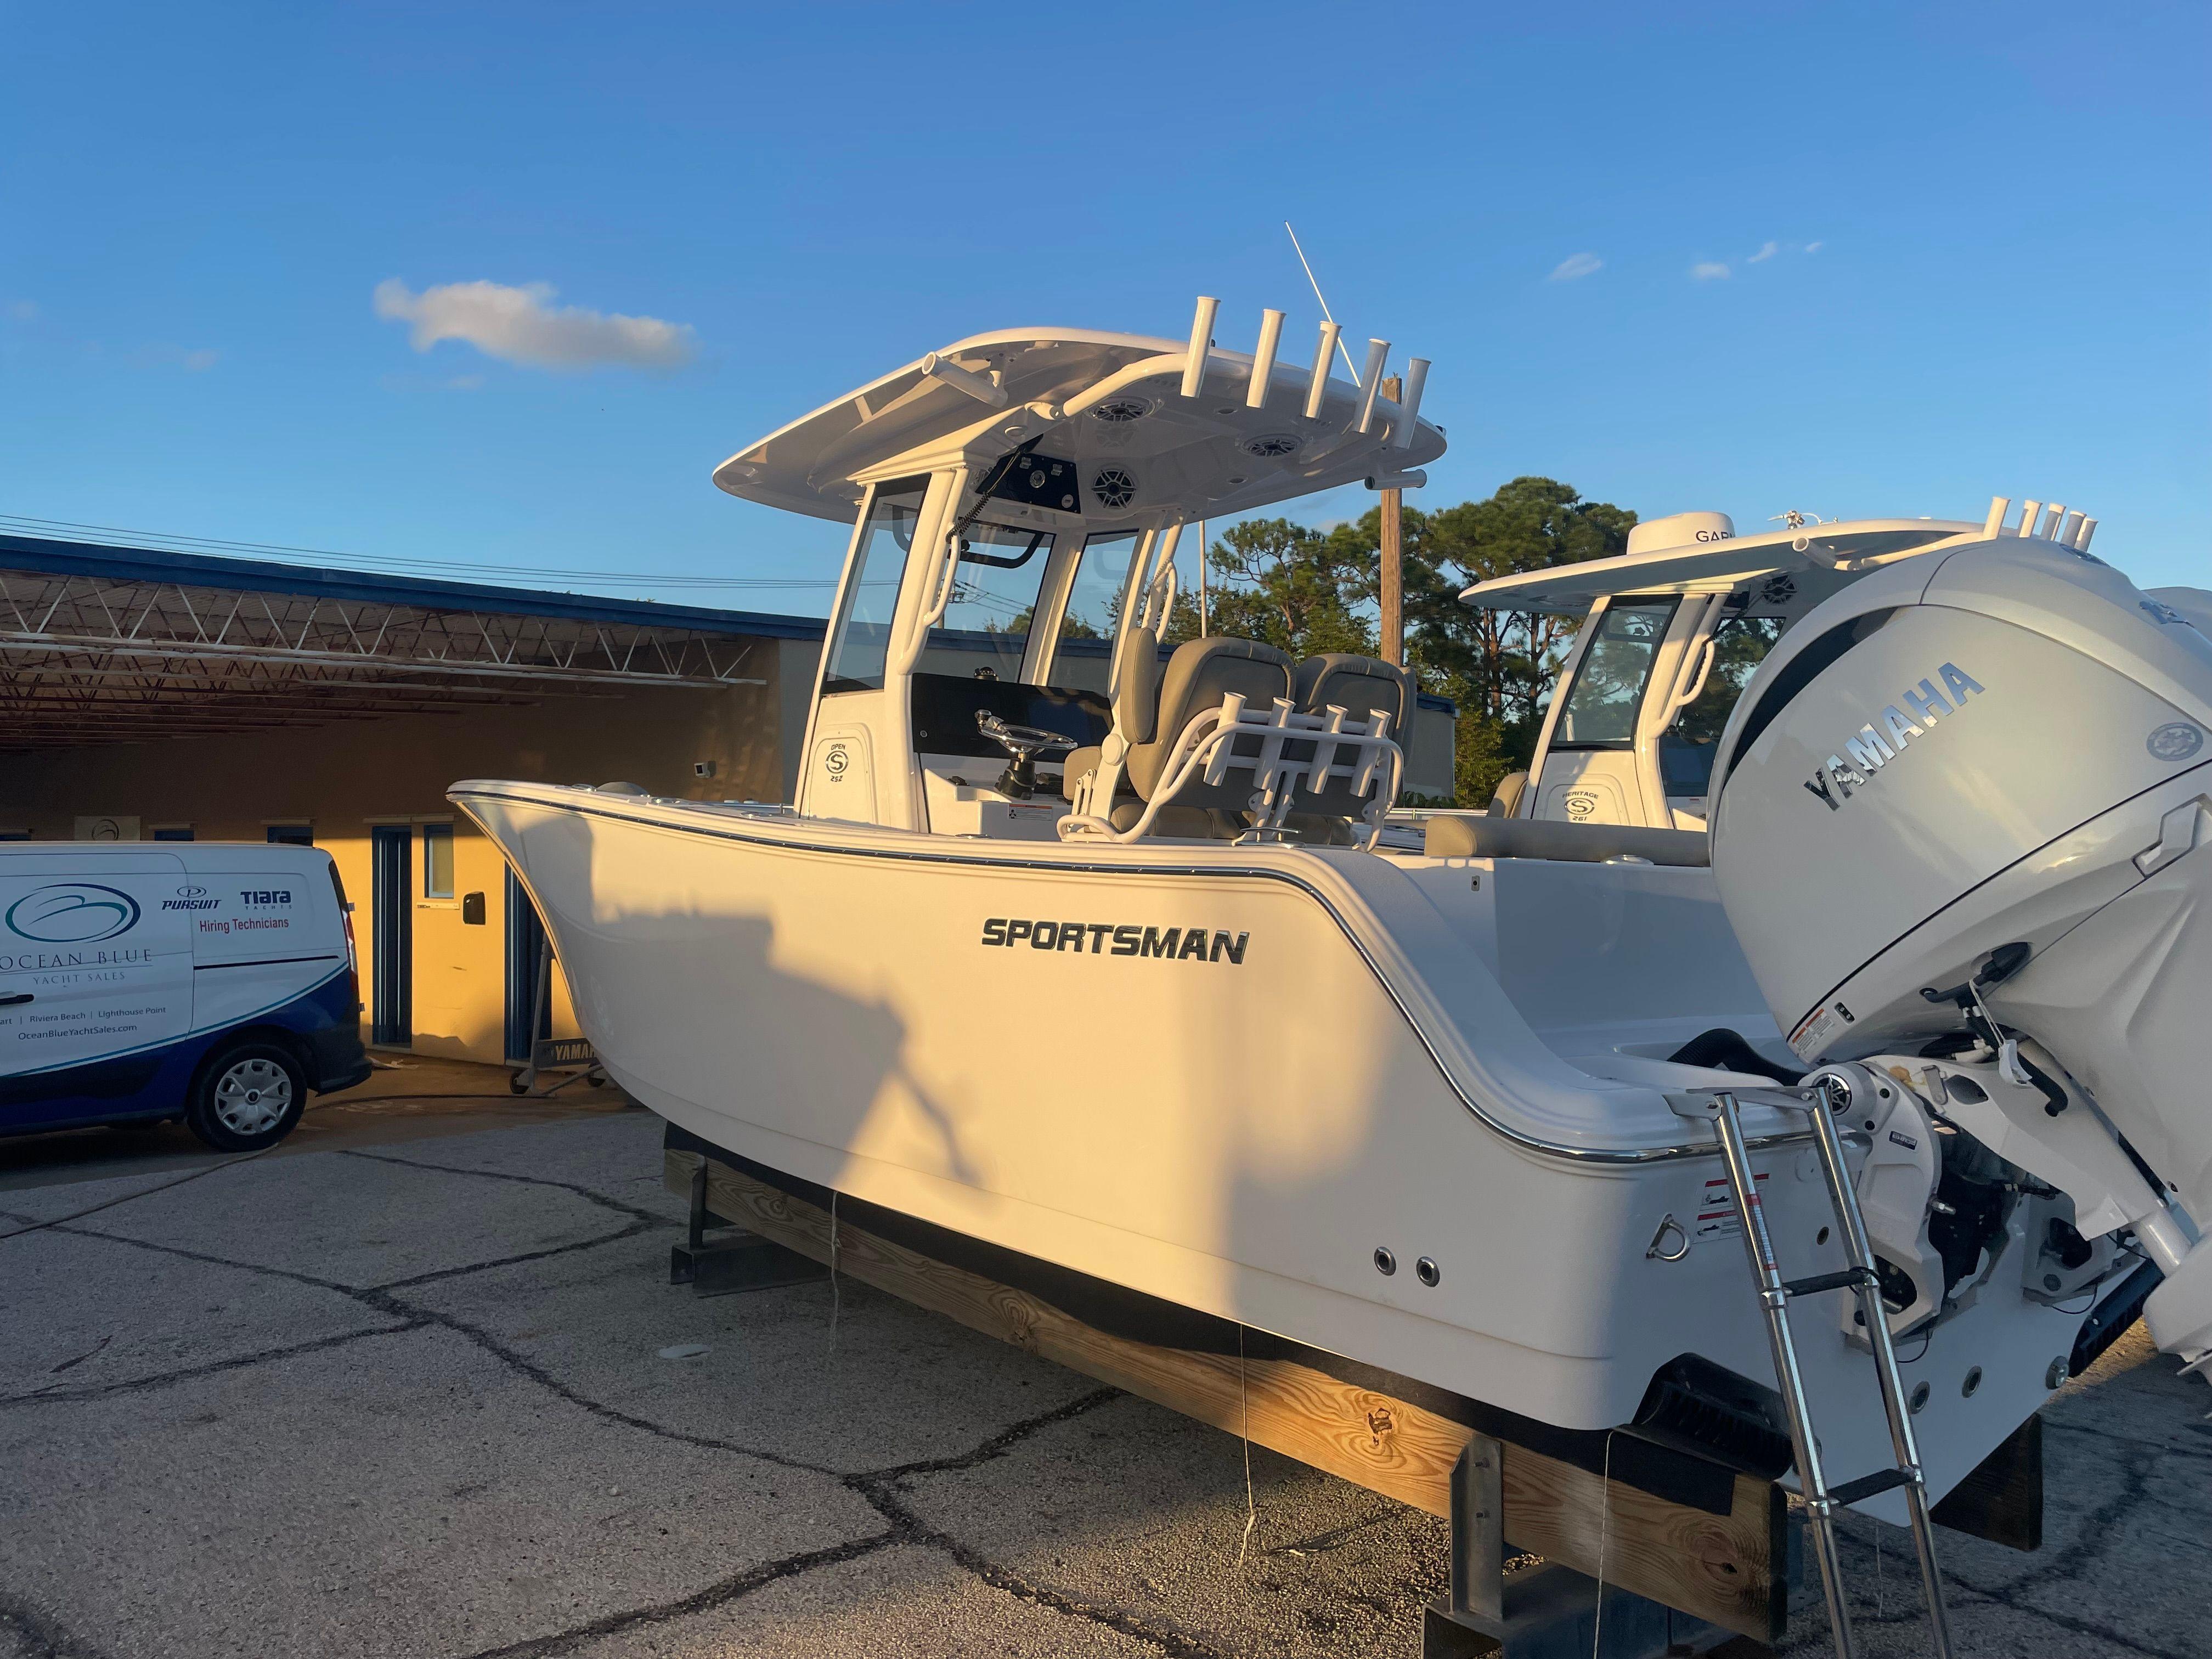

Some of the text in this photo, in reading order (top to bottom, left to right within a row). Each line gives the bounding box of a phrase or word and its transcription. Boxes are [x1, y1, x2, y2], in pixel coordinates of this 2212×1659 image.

[1803, 662, 1985, 811] YAMAHA
[1562, 791, 1599, 799] HERITAGE
[162, 899, 222, 910] PURSUIT
[200, 917, 290, 934] Hiring Technicians
[981, 918, 1250, 964] SPORTSMAN
[0, 949, 153, 970] OCEAN BLUE
[33, 972, 126, 985] YACHT SALES
[60, 1012, 86, 1021] Beach
[98, 1009, 144, 1019] Lighthouse
[18, 1025, 137, 1040] OceanBlueYachtSales.com
